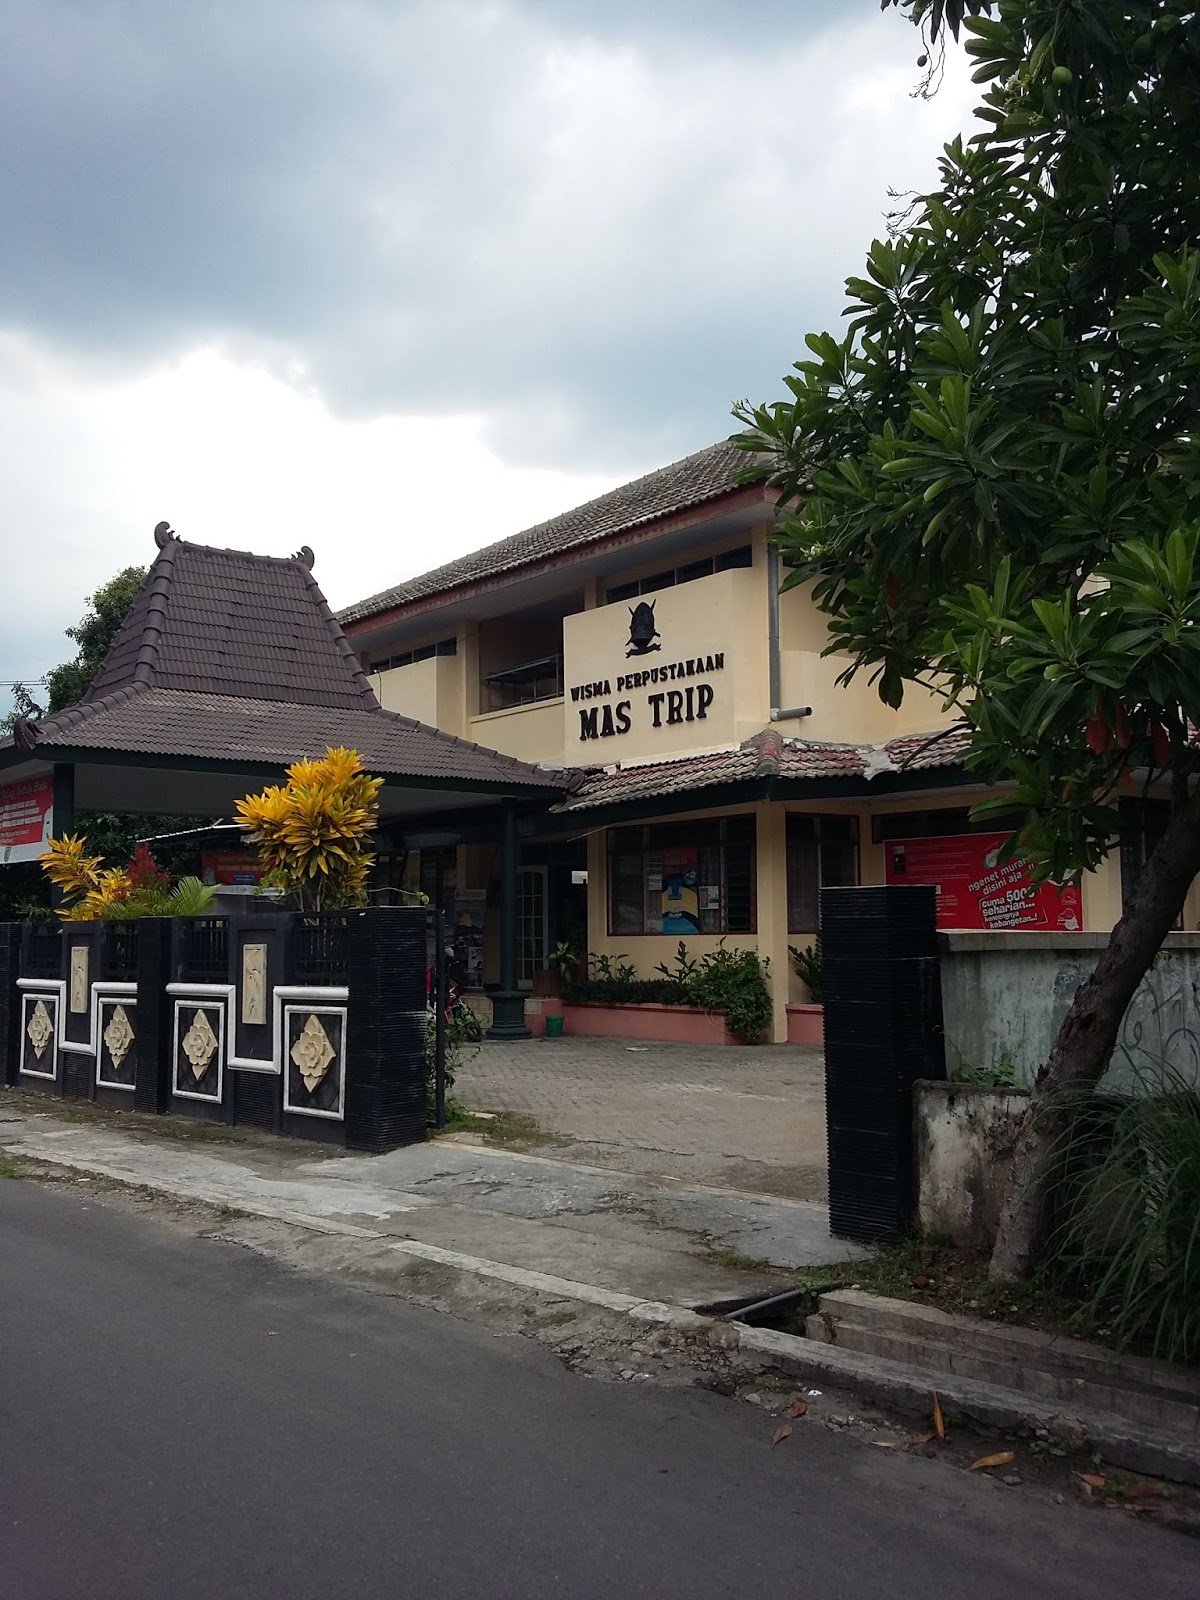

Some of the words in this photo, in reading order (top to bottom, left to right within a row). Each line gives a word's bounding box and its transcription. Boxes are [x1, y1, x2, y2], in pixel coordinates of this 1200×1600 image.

[570, 680, 612, 702] WISMA
[616, 652, 725, 692] PERPUSTAKAAN
[579, 700, 632, 741] MAS
[648, 684, 714, 728] TRIP
[967, 870, 1000, 892] ngenet
[982, 877, 1007, 895] disini
[981, 897, 1005, 908] cuma
